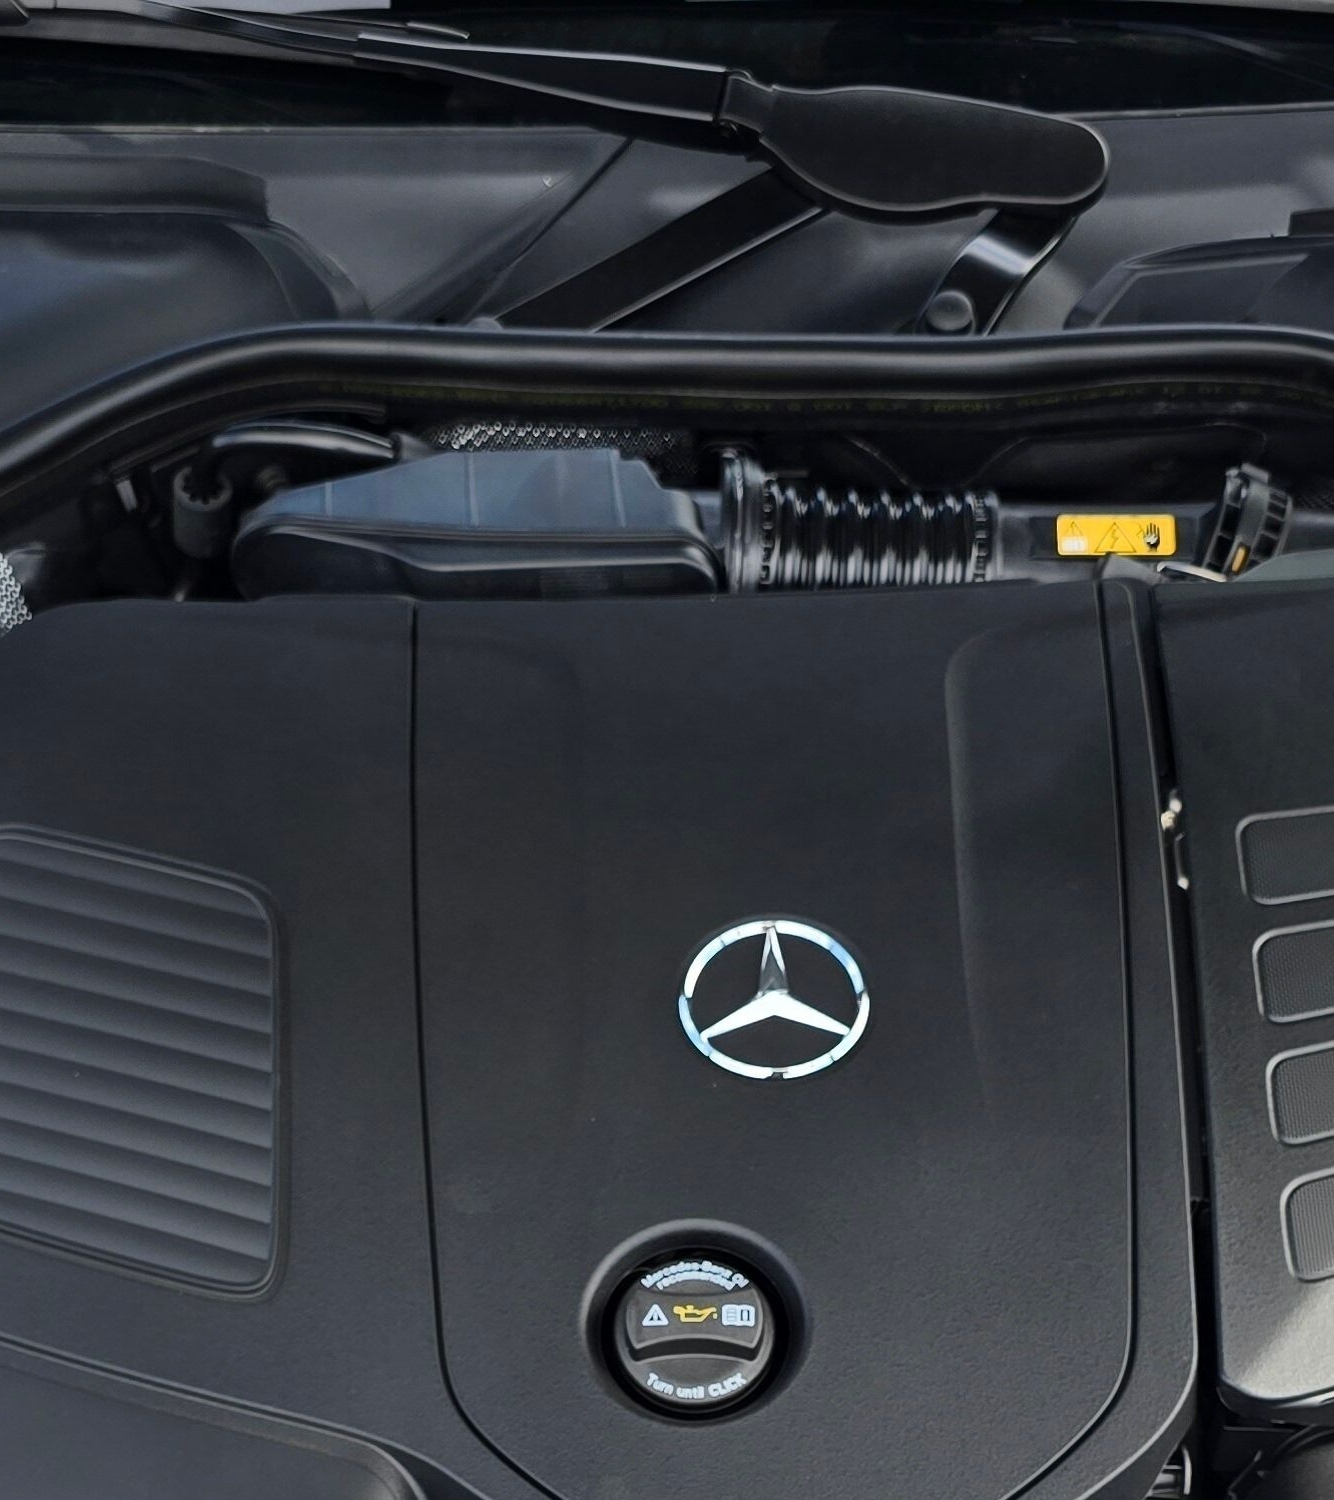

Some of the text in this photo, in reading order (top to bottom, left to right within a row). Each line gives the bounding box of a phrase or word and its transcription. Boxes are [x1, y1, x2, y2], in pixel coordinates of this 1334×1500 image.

[646, 1372, 748, 1399] Turn until CLICK
